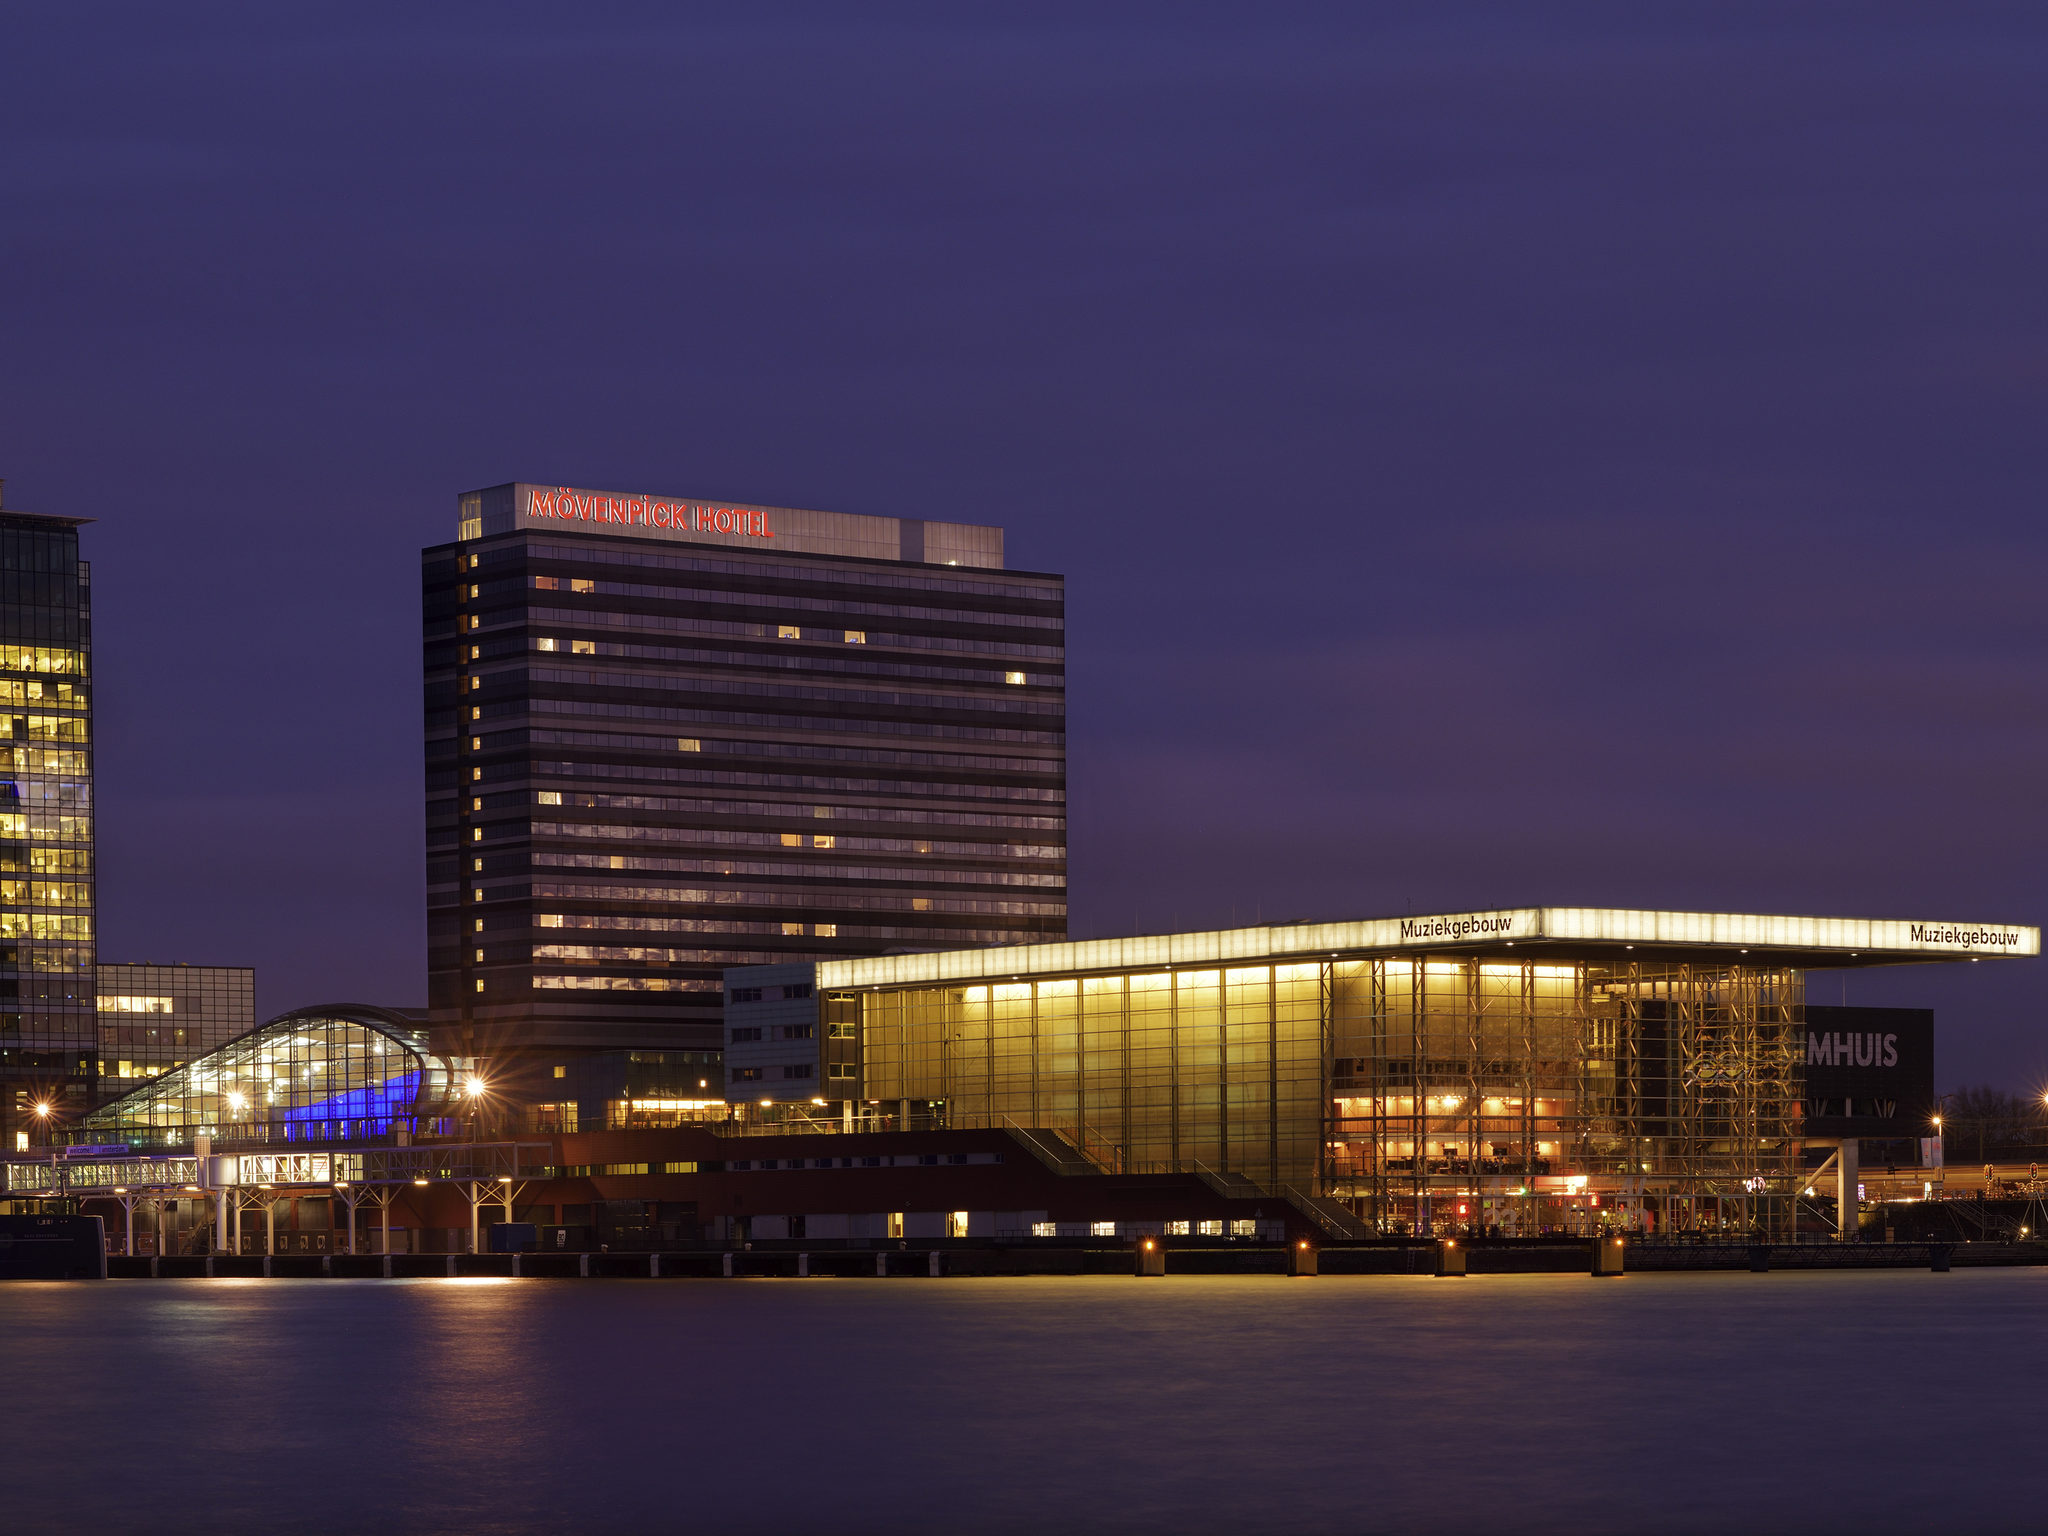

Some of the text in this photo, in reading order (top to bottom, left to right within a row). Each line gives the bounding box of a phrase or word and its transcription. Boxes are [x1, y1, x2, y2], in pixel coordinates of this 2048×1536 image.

[694, 505, 775, 538] HOTEL
[1401, 915, 1512, 939] Muziekgebouw
[1911, 924, 2019, 949] Muziekgebouw
